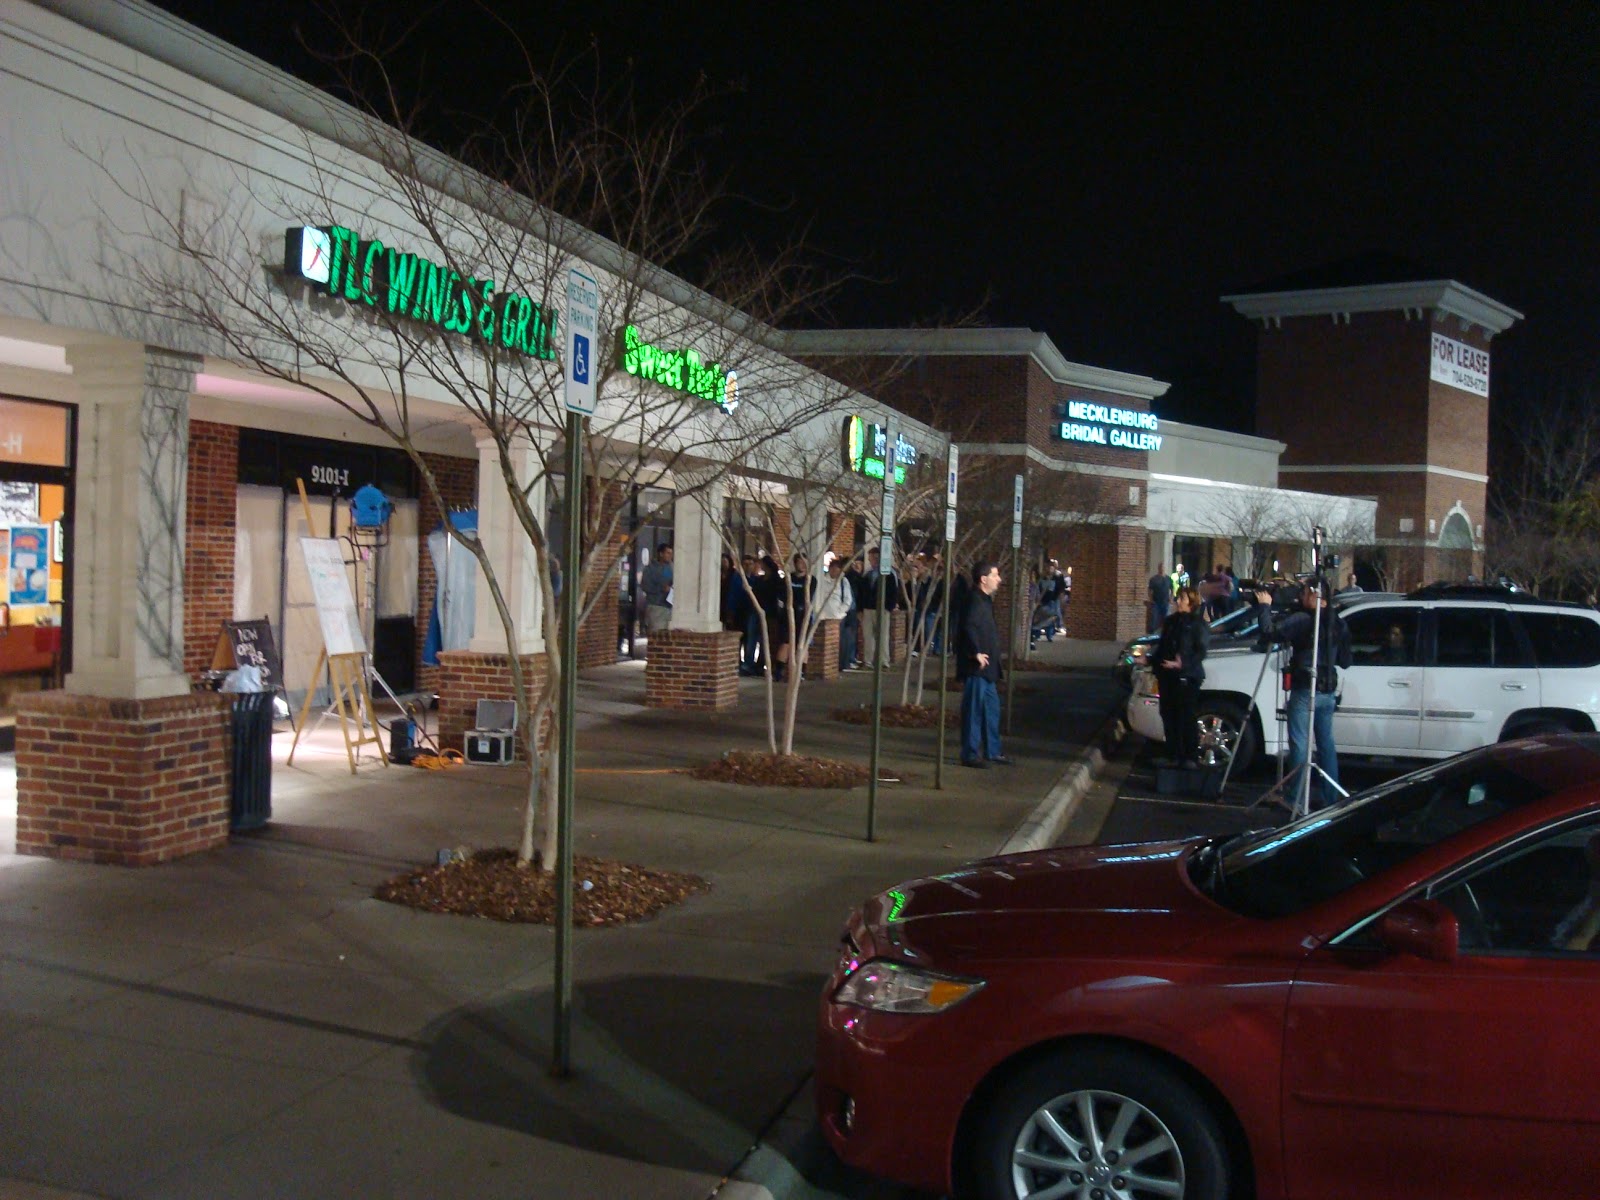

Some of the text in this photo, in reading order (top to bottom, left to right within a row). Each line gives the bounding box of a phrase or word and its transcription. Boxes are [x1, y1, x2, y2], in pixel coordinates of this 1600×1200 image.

[330, 226, 384, 306] TLC
[388, 247, 477, 335] WINGS
[479, 279, 496, 347] &
[569, 283, 596, 309] RESERVED
[569, 306, 594, 332] PARKING
[1433, 338, 1454, 364] FOR
[1457, 346, 1488, 376] LEASE
[1068, 400, 1158, 431] MECKLENBURG
[1060, 422, 1163, 451] BRIDAL GALLERY
